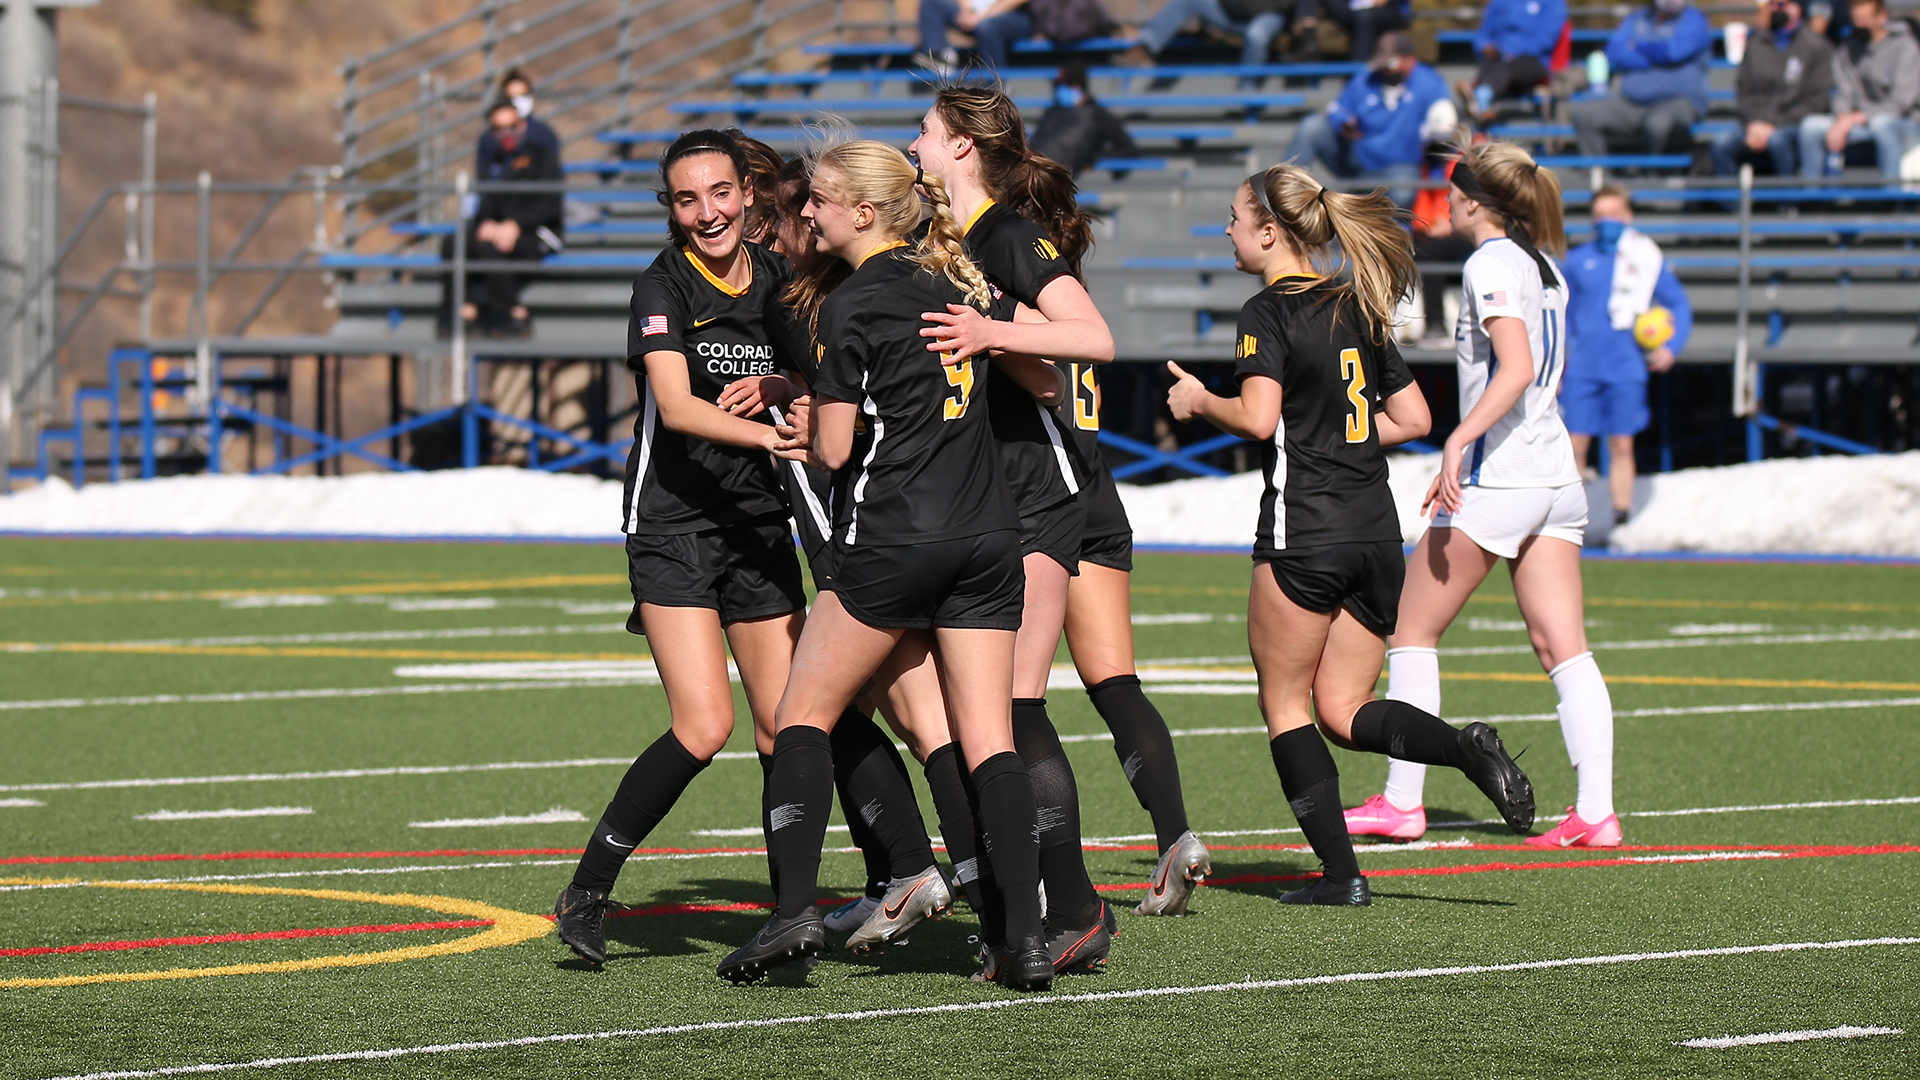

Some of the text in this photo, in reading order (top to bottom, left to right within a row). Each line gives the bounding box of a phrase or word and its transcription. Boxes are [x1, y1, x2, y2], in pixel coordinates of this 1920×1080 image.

[696, 341, 774, 360] COLORAD
[706, 359, 775, 376] COLLEGE
[936, 325, 975, 422] 9
[1537, 309, 1557, 387] 11
[1339, 347, 1370, 444] 3
